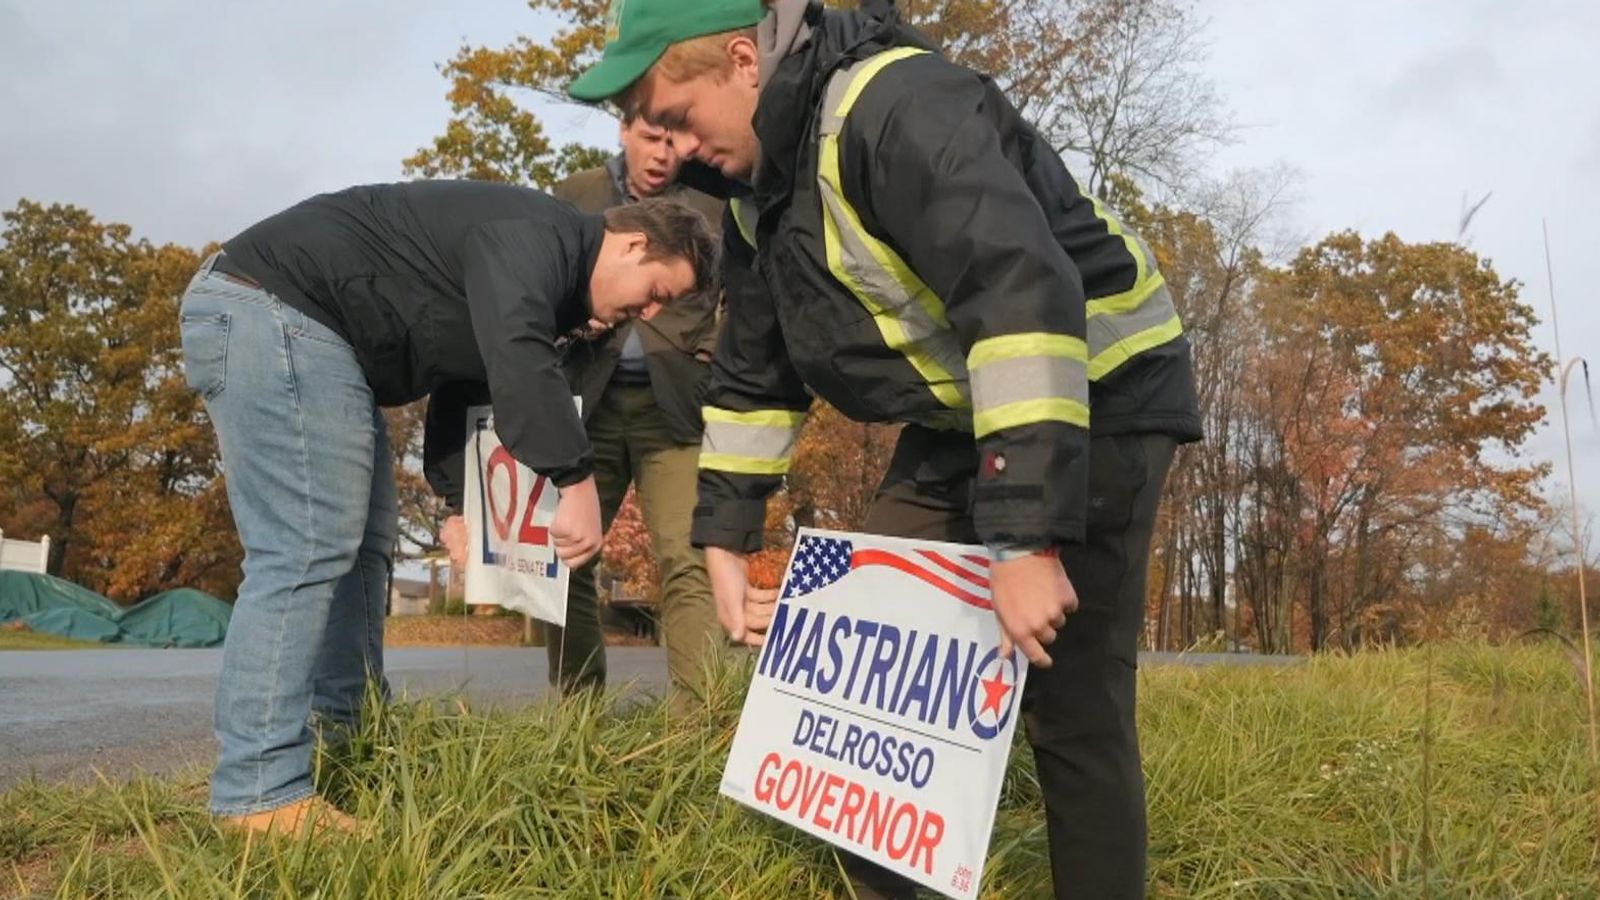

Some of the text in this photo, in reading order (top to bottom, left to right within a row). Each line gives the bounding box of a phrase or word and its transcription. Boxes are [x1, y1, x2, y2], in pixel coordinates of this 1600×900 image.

[758, 604, 1018, 740] MASTRIANO
[793, 710, 934, 789] DELROSSO
[754, 753, 944, 875] GOVERNOR
